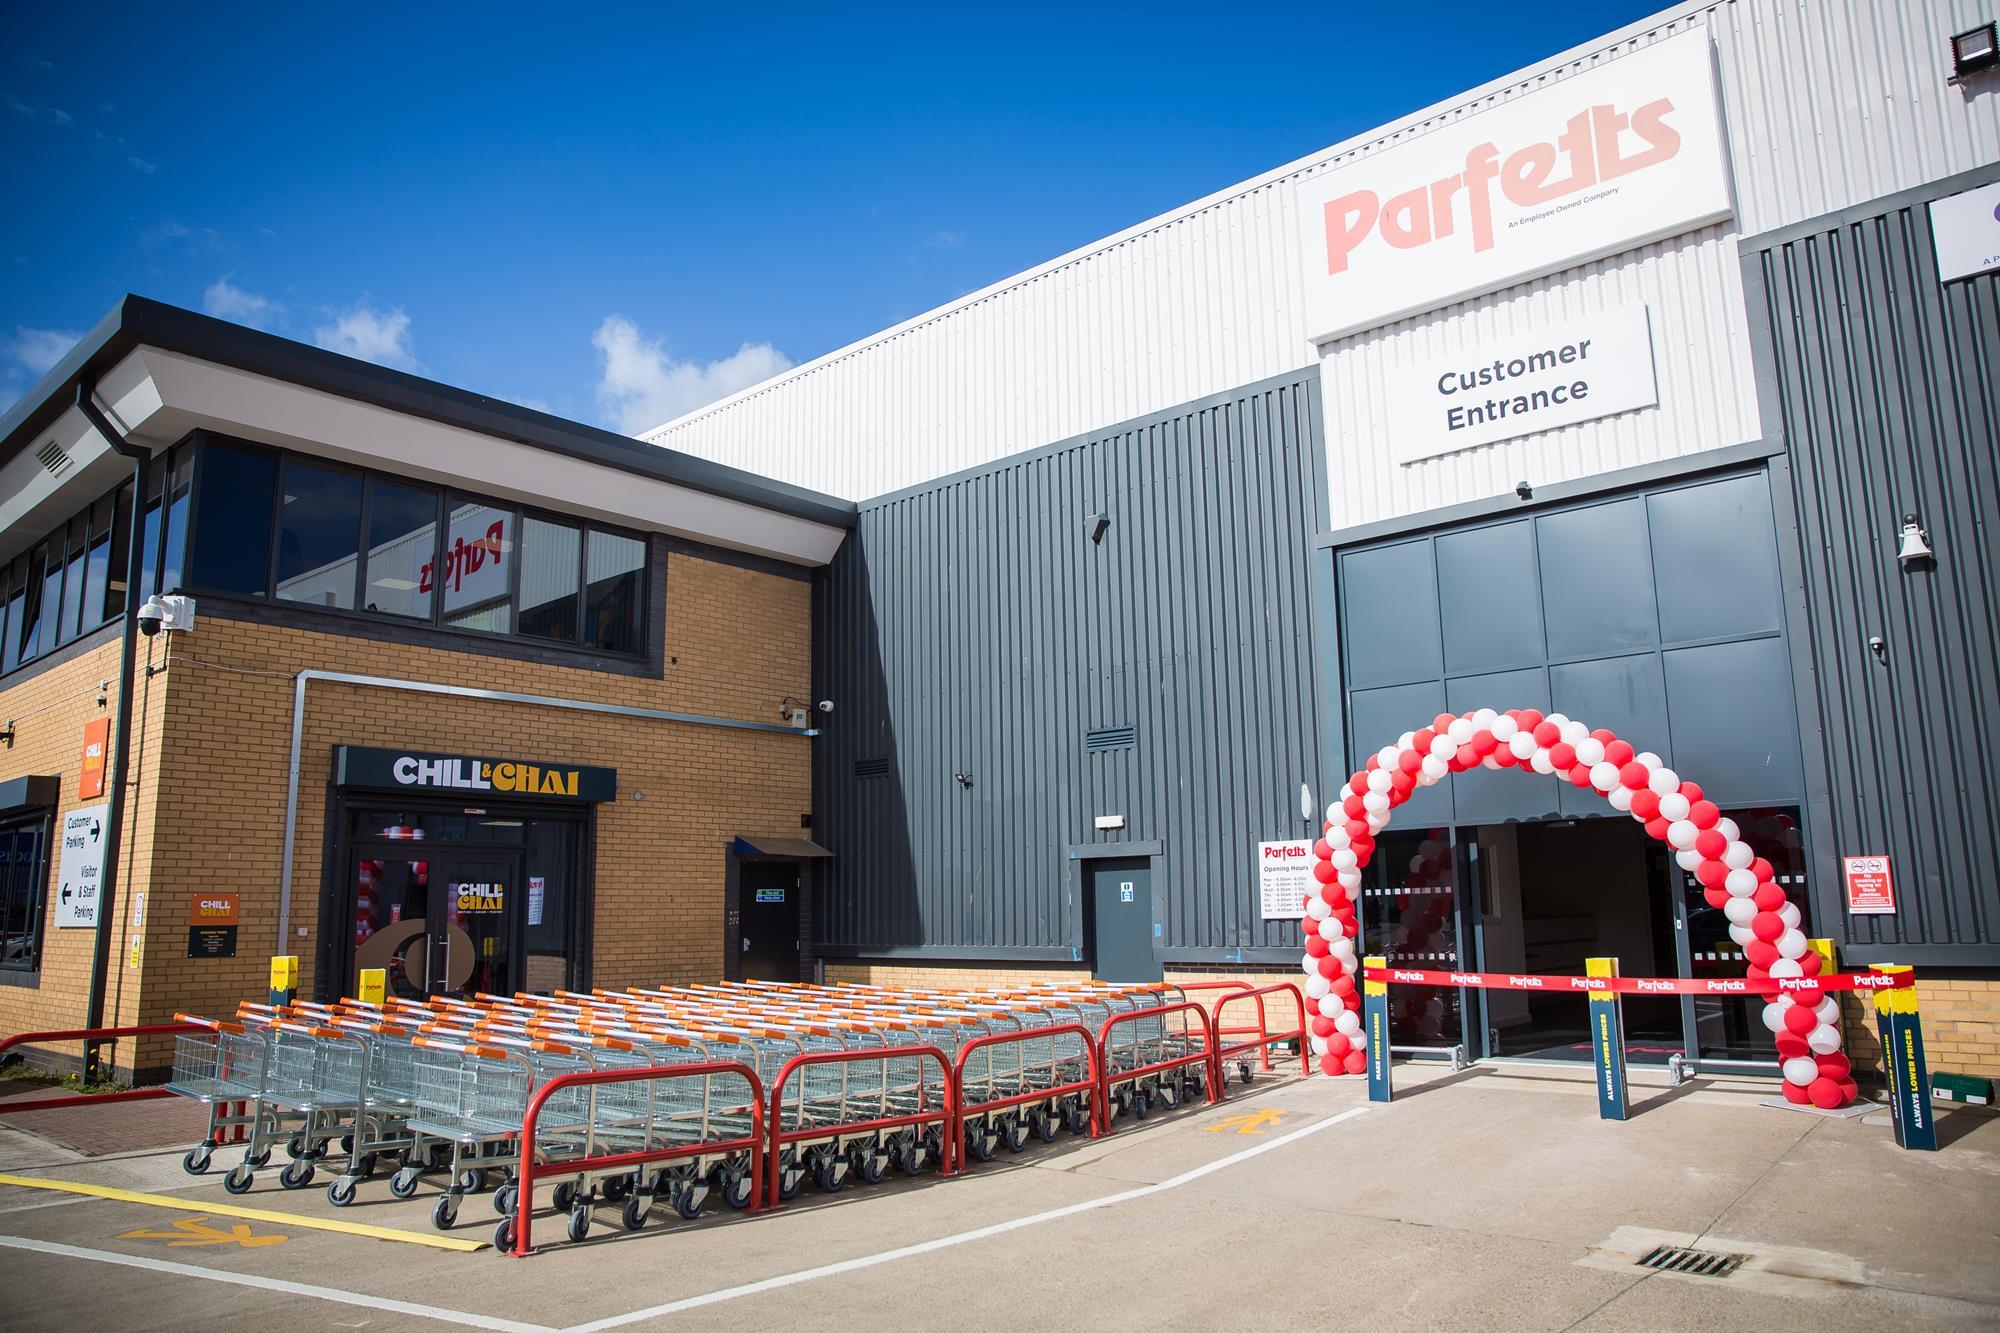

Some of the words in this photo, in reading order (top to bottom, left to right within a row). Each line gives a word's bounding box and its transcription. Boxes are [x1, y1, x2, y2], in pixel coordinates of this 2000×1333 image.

[1323, 97, 1681, 276] Parfetts
[1520, 209, 1555, 225] Employee
[1556, 200, 1582, 213] Owned
[1583, 187, 1620, 203] Company
[1437, 336, 1591, 397] Customer
[1447, 379, 1589, 432] Entrance
[393, 756, 490, 790] CHILL
[482, 762, 492, 778] &
[492, 762, 580, 796] CHAI
[68, 816, 92, 830] Customer
[66, 835, 85, 849] Parking
[1264, 846, 1306, 861] Parfetts
[81, 865, 98, 878] Visitor
[83, 884, 96, 898] Staff
[457, 896, 503, 910] CHAI
[458, 883, 503, 898] CHILL
[74, 906, 94, 920] Parking
[200, 900, 231, 909] CHILL
[1600, 1014, 1608, 1040] PRICES
[1602, 1042, 1611, 1069] LOWER
[1904, 1028, 1914, 1059] PRICES
[1606, 1070, 1614, 1101] ALWAYS
[1908, 1060, 1919, 1092] LOWER
[1914, 1092, 1923, 1129] ALWAYS
